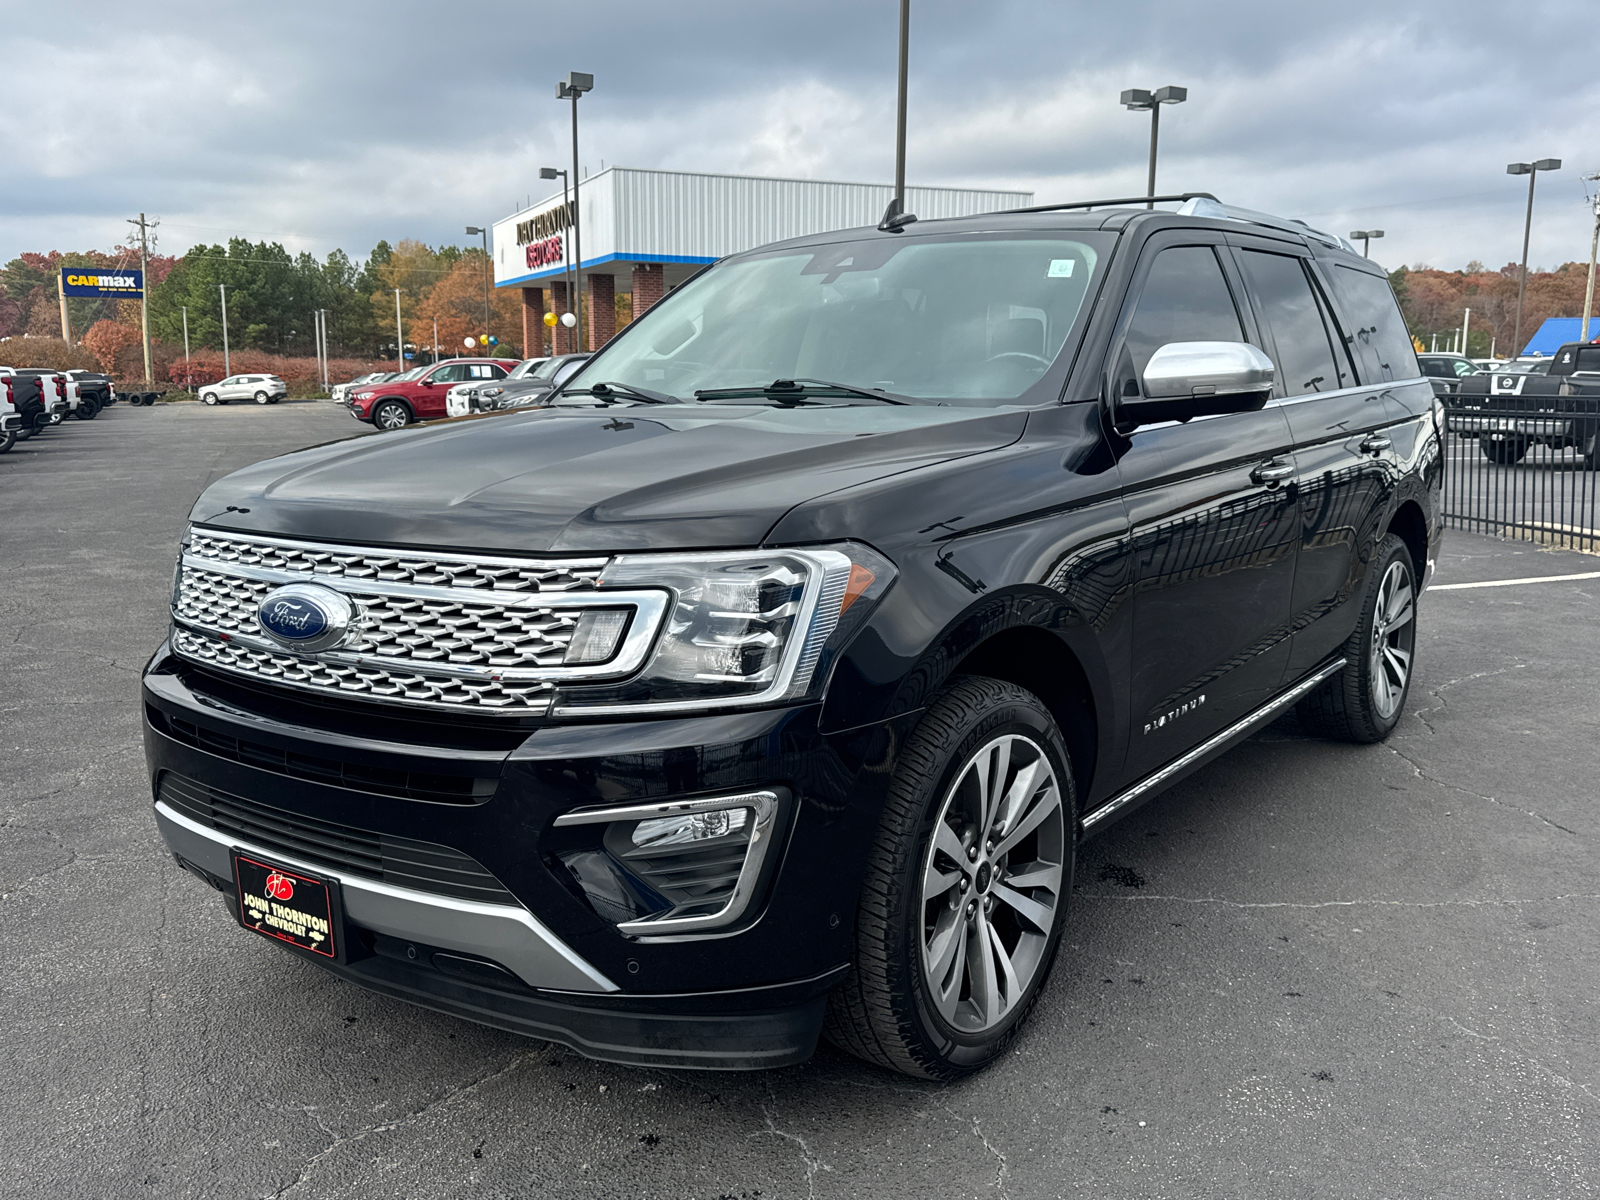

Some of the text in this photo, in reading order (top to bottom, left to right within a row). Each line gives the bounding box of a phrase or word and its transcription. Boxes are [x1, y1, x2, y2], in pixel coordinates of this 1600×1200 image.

[526, 236, 563, 269] USED CARS
[269, 601, 311, 631] Ford
[1143, 694, 1206, 735] PLATINUM
[244, 892, 329, 934] JOHN THORNTON
[265, 913, 306, 937] CHEVROLET
